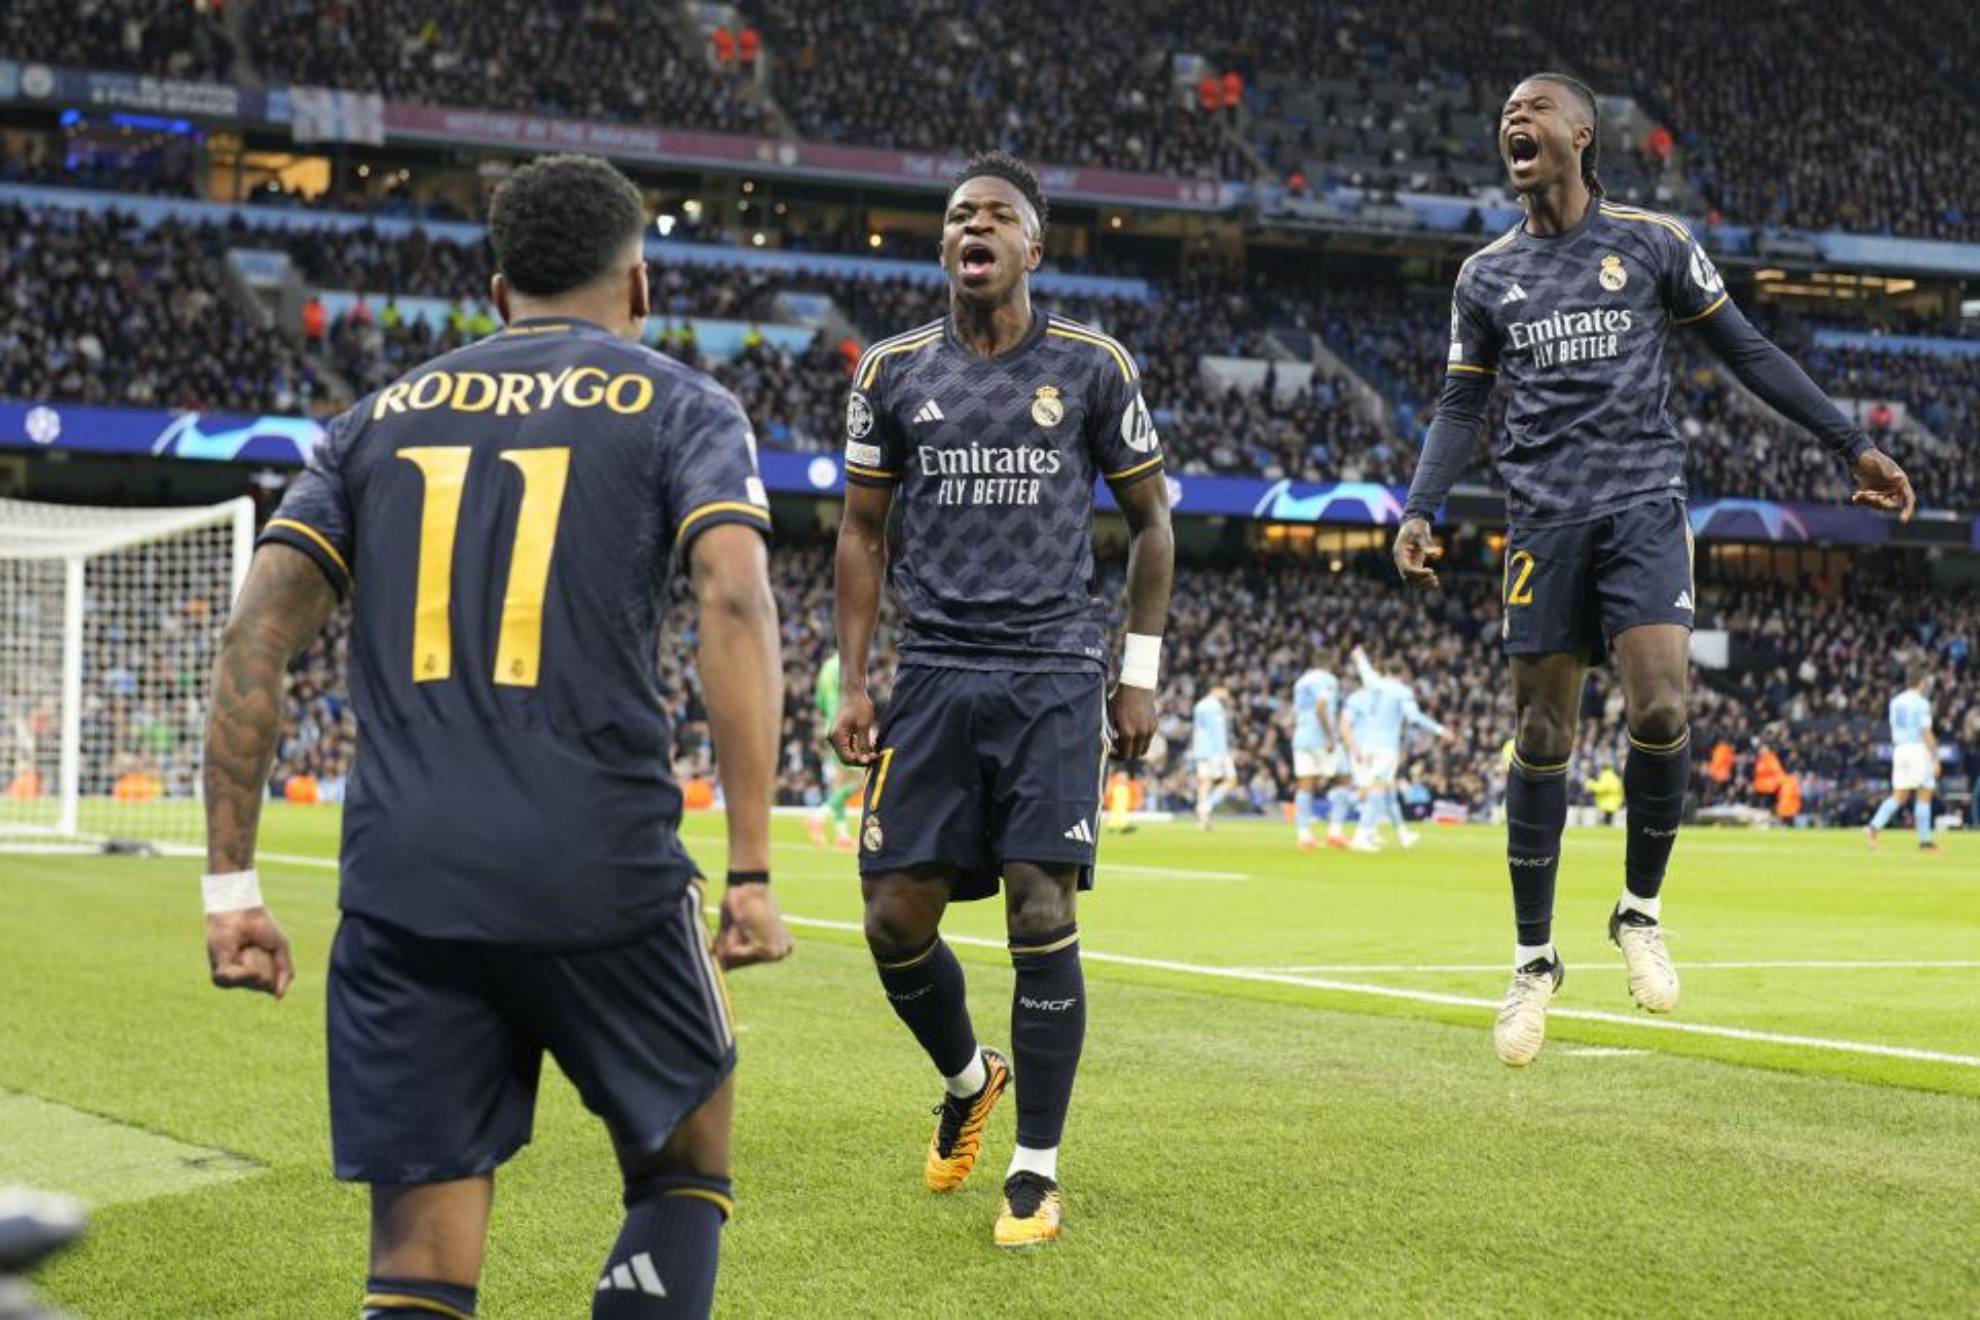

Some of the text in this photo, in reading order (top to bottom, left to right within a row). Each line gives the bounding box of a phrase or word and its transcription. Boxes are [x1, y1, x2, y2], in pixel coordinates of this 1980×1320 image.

[1508, 306, 1632, 350] Emirates
[1560, 334, 1618, 362] BETTER
[372, 366, 654, 420] RODRYGO
[918, 440, 1061, 476] Emirates
[937, 478, 1040, 505] FLY BETTER
[396, 446, 571, 688] 11
[1019, 996, 1076, 1011] RMCF
